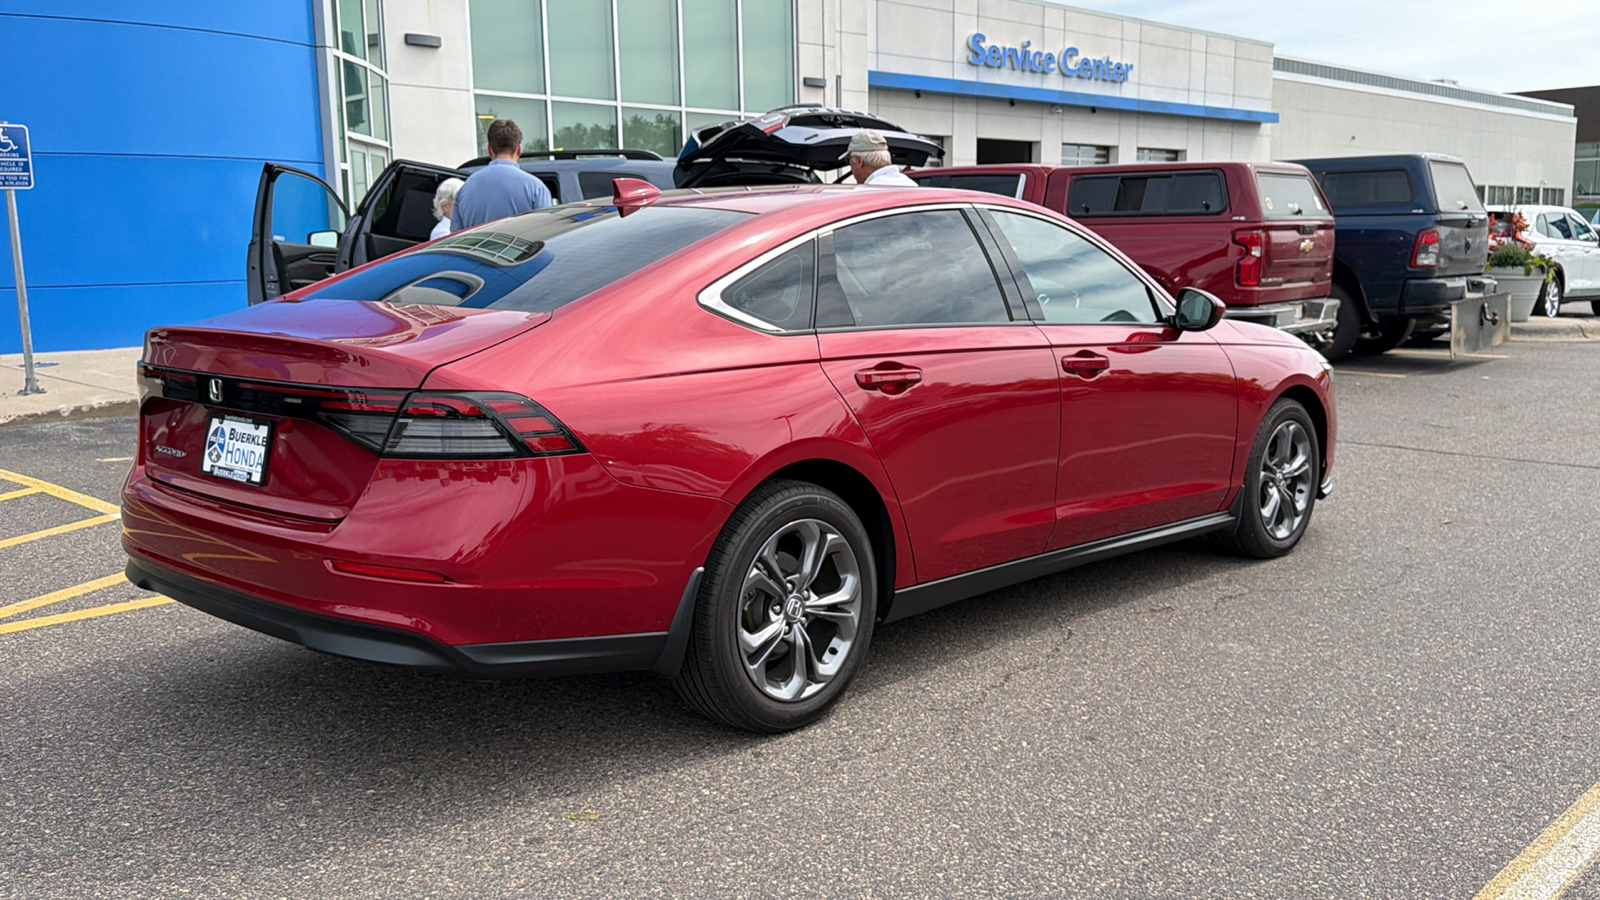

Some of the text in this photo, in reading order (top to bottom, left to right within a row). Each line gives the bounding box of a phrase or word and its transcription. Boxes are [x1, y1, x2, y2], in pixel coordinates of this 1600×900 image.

[967, 33, 1133, 82] Service Center
[229, 428, 267, 446] BUERKLE
[225, 441, 263, 469] HONDA
